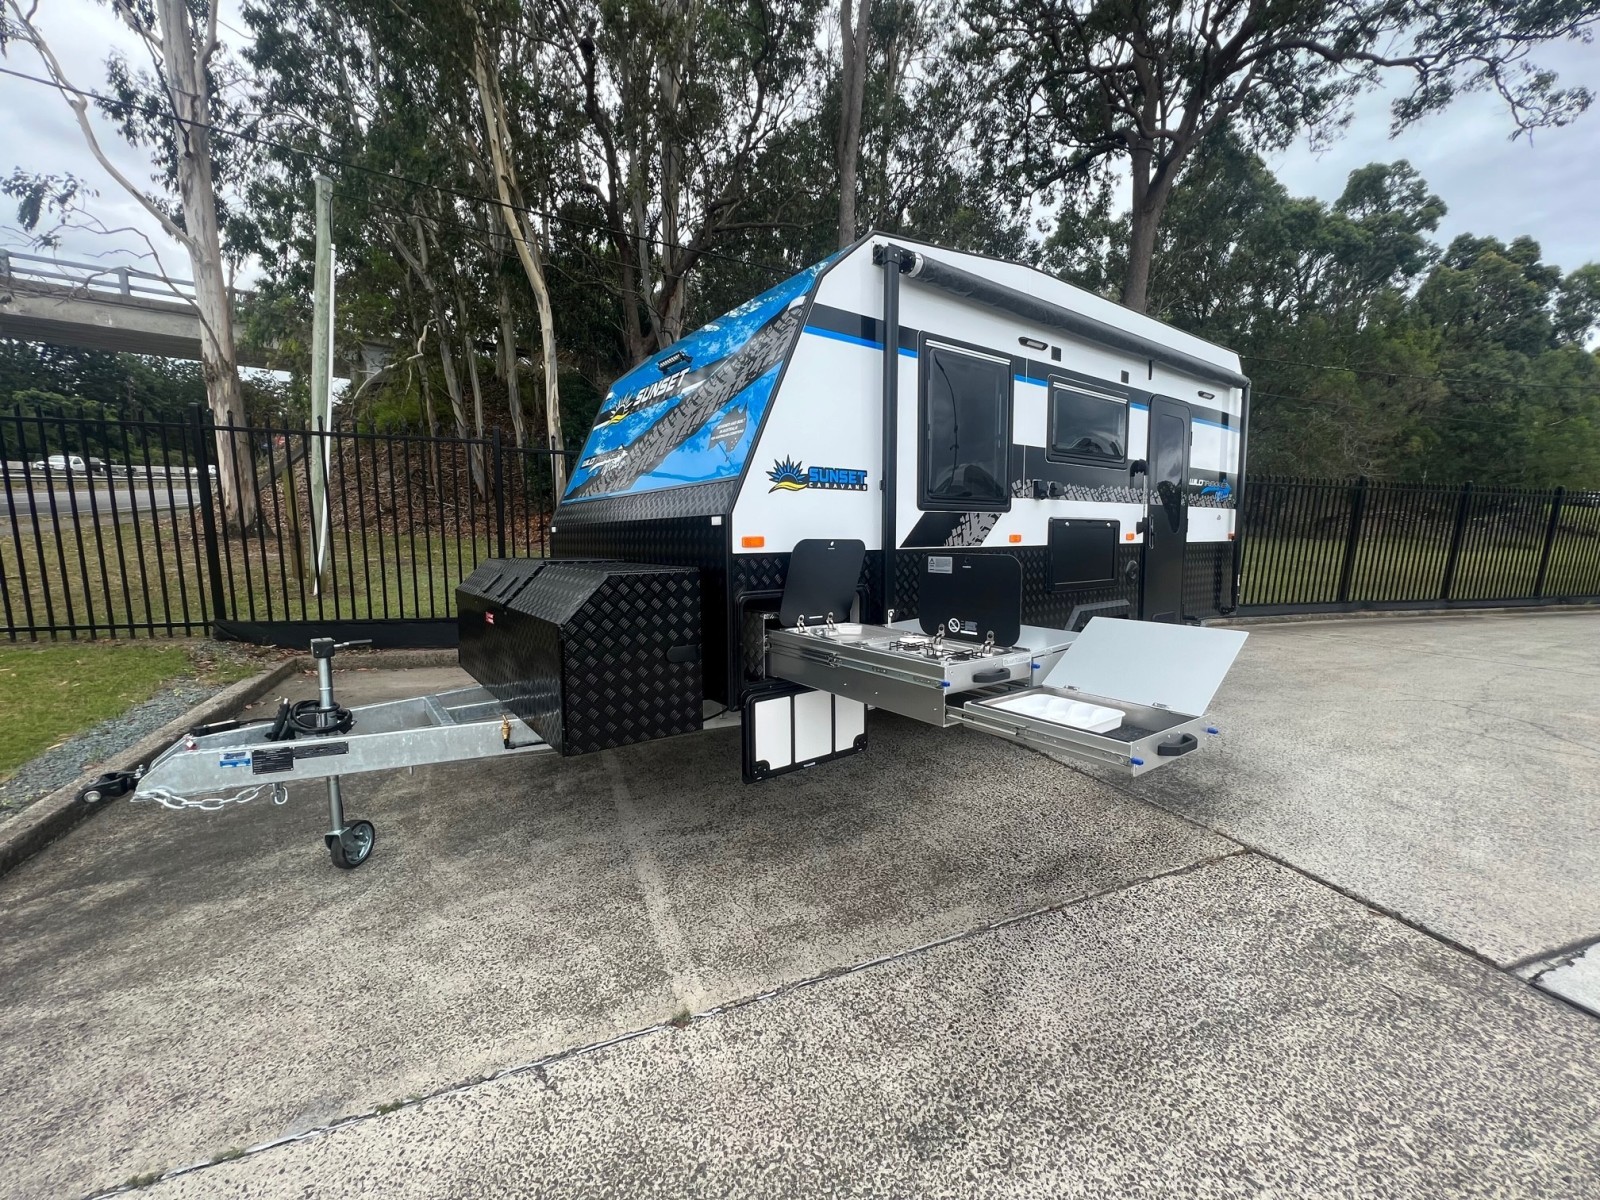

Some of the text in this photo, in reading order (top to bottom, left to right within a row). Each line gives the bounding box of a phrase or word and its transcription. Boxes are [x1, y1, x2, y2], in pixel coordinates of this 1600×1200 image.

[632, 367, 690, 407] SUNSET
[808, 467, 867, 484] SUNSET
[808, 482, 868, 490] CARAVANS
